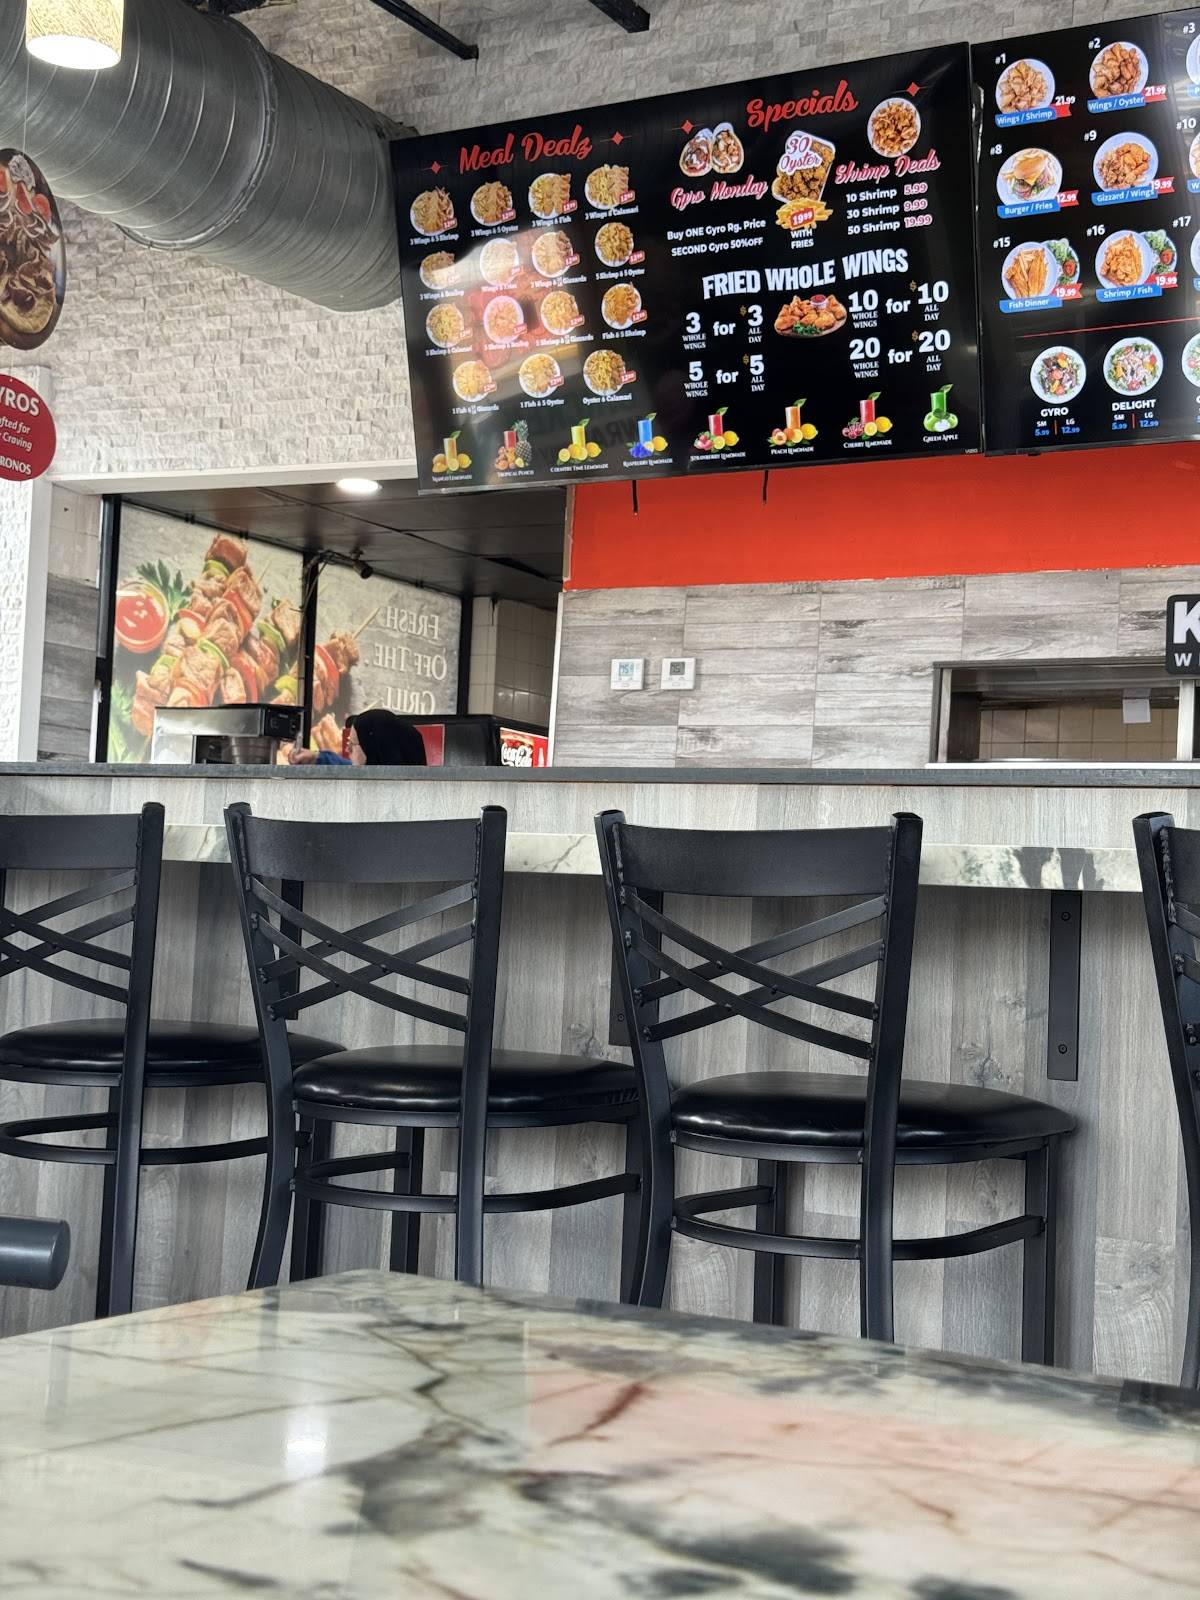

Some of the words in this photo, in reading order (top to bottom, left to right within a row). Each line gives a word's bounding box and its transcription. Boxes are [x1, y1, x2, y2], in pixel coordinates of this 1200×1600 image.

[1183, 22, 1195, 34] #3
[1088, 38, 1100, 49] #2
[995, 53, 1006, 64] #1
[1145, 86, 1166, 96] 21.99
[747, 80, 858, 132] Specials
[1055, 96, 1076, 106] 21.99
[1088, 101, 1112, 110] Wings
[1119, 96, 1144, 107] Oyster
[997, 115, 1020, 124] Wings
[1026, 111, 1052, 120] Shrimp
[1176, 118, 1196, 130] #10
[1084, 130, 1097, 141] #9
[460, 132, 515, 174] Meal
[521, 124, 593, 162] Dealz
[788, 136, 810, 154] 30
[990, 144, 1002, 155] #8
[781, 152, 820, 172] Oyster
[834, 161, 890, 184] Shrimp
[894, 149, 941, 177] Deals
[1151, 180, 1172, 190] 19.99
[671, 188, 706, 211] Gyro
[710, 174, 768, 201] Monday
[846, 194, 857, 203] 10
[859, 189, 897, 200] Shrimp
[904, 182, 928, 195] 5.99
[1057, 192, 1076, 202] 12.99
[1097, 191, 1124, 201] Gizzard
[1130, 189, 1154, 198] Wings
[589, 210, 608, 219] Wings
[613, 206, 639, 216] Calamari
[847, 210, 860, 219] 30
[862, 205, 900, 217] Shrimp
[904, 199, 928, 212] 9.99
[1005, 205, 1029, 215] Burger
[1035, 202, 1053, 210] Fries
[536, 219, 554, 227] Wings
[848, 226, 860, 235] 50
[863, 221, 900, 233] Shrimp
[904, 214, 932, 228] 19.99
[1173, 216, 1192, 227] #17
[475, 228, 492, 237] Wings
[667, 231, 683, 240] Buy
[685, 227, 704, 237] ONE
[706, 226, 726, 236] Gyro
[728, 223, 741, 233] Rg.
[744, 219, 766, 229] Price
[791, 229, 812, 238] WITH
[1086, 224, 1105, 236] #16
[791, 239, 814, 249] FRIES
[993, 237, 1010, 248] #15
[672, 244, 707, 256] SECOND
[709, 242, 729, 253] Gyro
[600, 271, 619, 280] Shrimp
[628, 268, 645, 277] Oyster
[702, 270, 760, 300] FRIED
[765, 260, 836, 291] WHOLE
[842, 248, 909, 280] WINGS
[1155, 276, 1177, 286] 19.99
[1055, 288, 1077, 297] 19.99
[1104, 289, 1131, 298] Shrimp
[1138, 286, 1153, 294] Fish
[848, 289, 879, 312] 10
[886, 298, 911, 314] for
[1009, 301, 1023, 309] Fish
[1025, 299, 1049, 307] Dinner
[924, 304, 939, 312] ALL
[852, 311, 878, 320] WHOLE
[924, 313, 940, 321] DAY
[686, 312, 701, 333] 3
[713, 321, 736, 336] for
[853, 320, 877, 329] WINGS
[625, 329, 646, 339] Shrimp
[748, 327, 760, 335] ALL
[682, 334, 706, 342] WHOLE
[748, 335, 762, 343] DAY
[684, 342, 706, 350] WINGS
[849, 337, 880, 360] 20
[888, 349, 913, 364] for
[926, 355, 940, 363] ALL
[853, 361, 879, 370] WHOLE
[926, 363, 942, 372] DAY
[689, 361, 703, 381] 5
[716, 369, 739, 384] for
[854, 370, 879, 379] WINGS
[684, 381, 708, 390] WHOLE
[751, 384, 766, 392] DAY
[606, 393, 632, 401] Calamari
[686, 390, 708, 398] WINGS
[546, 399, 564, 407] Oyster
[1112, 399, 1156, 411] DELIGHT
[1040, 407, 1069, 417] GYRO
[18, 422, 30, 434] for
[1061, 426, 1080, 434] 12.99
[2, 432, 32, 451] Craving
